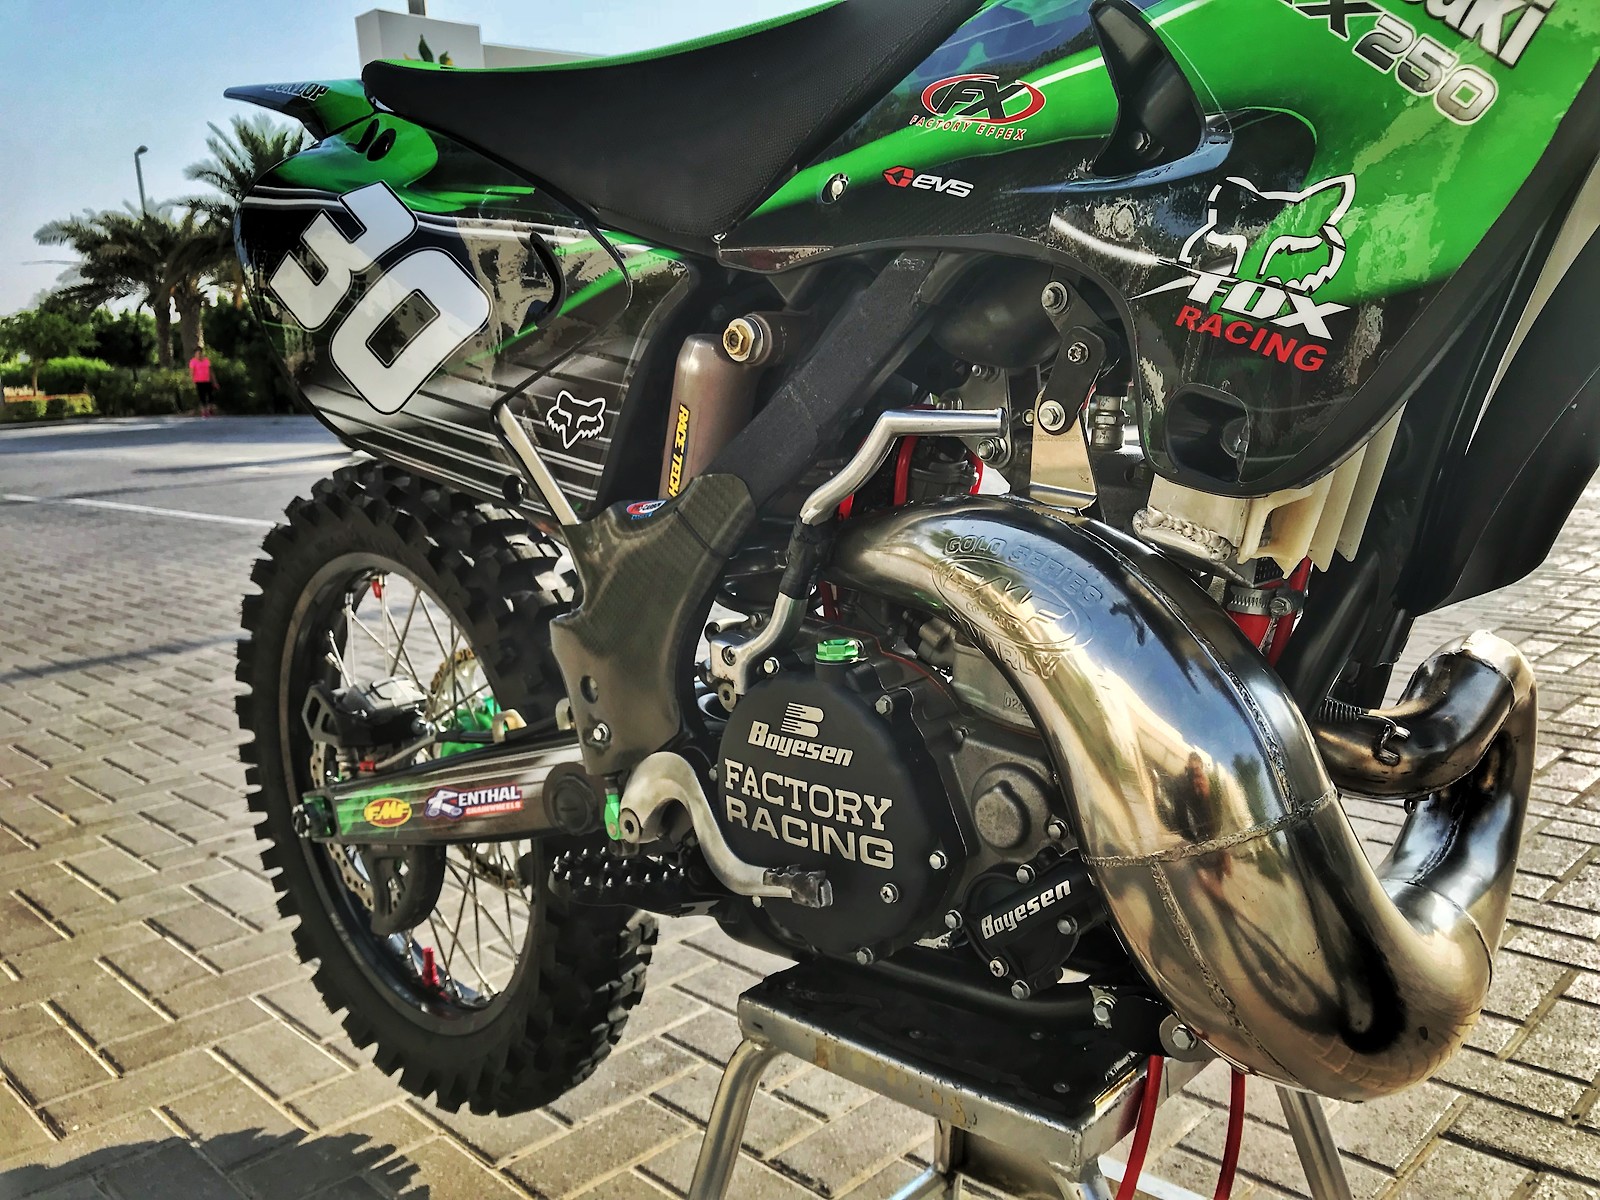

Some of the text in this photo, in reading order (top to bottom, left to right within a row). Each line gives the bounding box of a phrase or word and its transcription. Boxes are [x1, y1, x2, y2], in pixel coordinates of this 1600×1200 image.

[935, 78, 1027, 120] FX
[1352, 11, 1499, 125] 250
[909, 115, 1027, 140] FACTORY EFFEX
[268, 180, 492, 415] 30
[1155, 270, 1351, 340] FOX
[1175, 305, 1328, 371] RACING
[944, 535, 1104, 603] GOLD SERIES
[748, 720, 854, 767] Boyesen
[365, 801, 410, 821] FMF
[724, 758, 893, 831] FACTORY
[725, 795, 894, 870] RACING
[981, 879, 1072, 940] Boyesen
